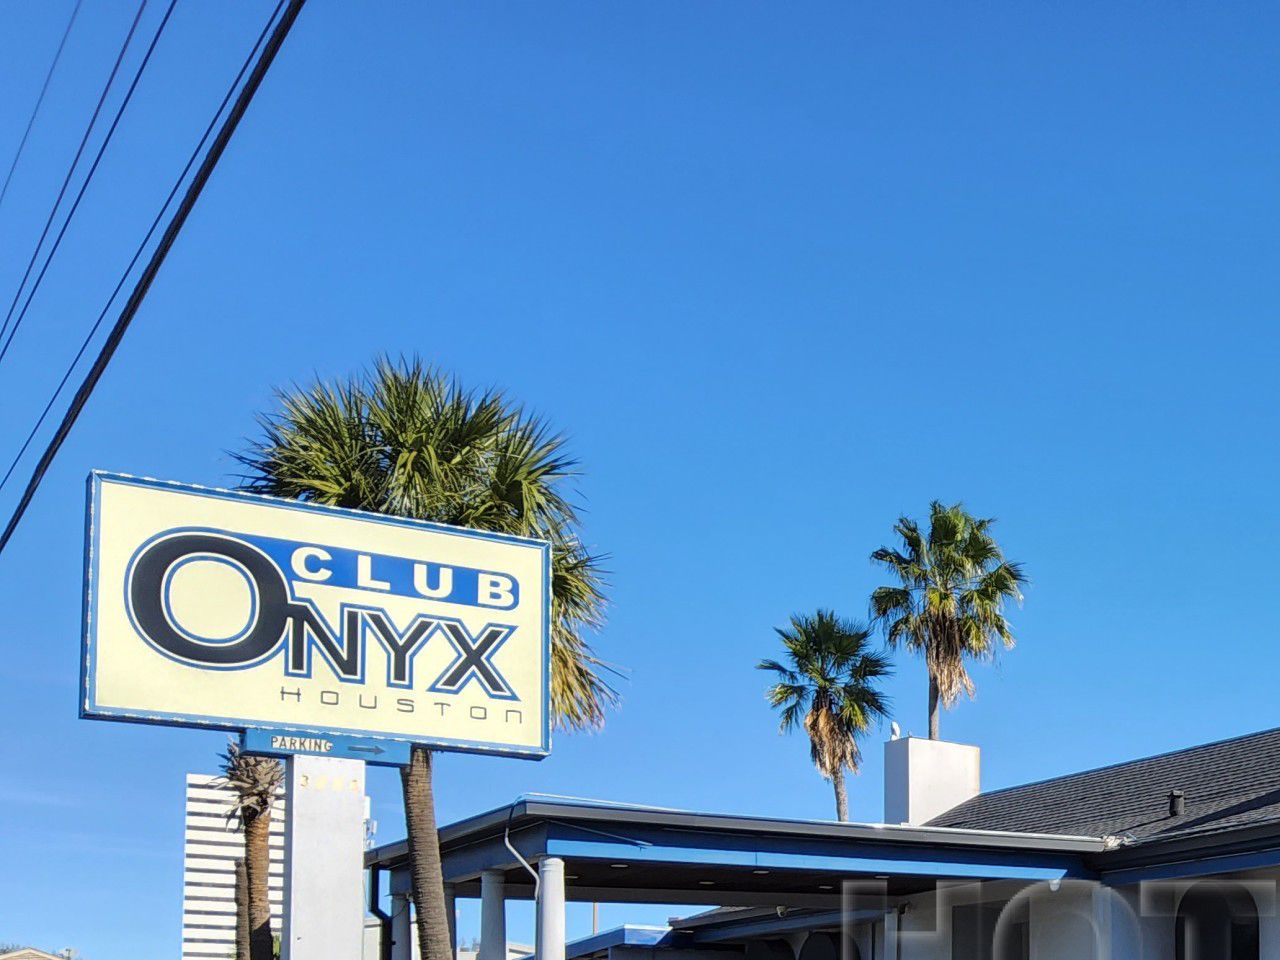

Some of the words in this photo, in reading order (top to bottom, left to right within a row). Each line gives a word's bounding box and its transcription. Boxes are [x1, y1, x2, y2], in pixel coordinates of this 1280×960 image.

[291, 547, 514, 608] CLUB
[124, 526, 520, 700] ONYX
[271, 736, 333, 752] PARKING
